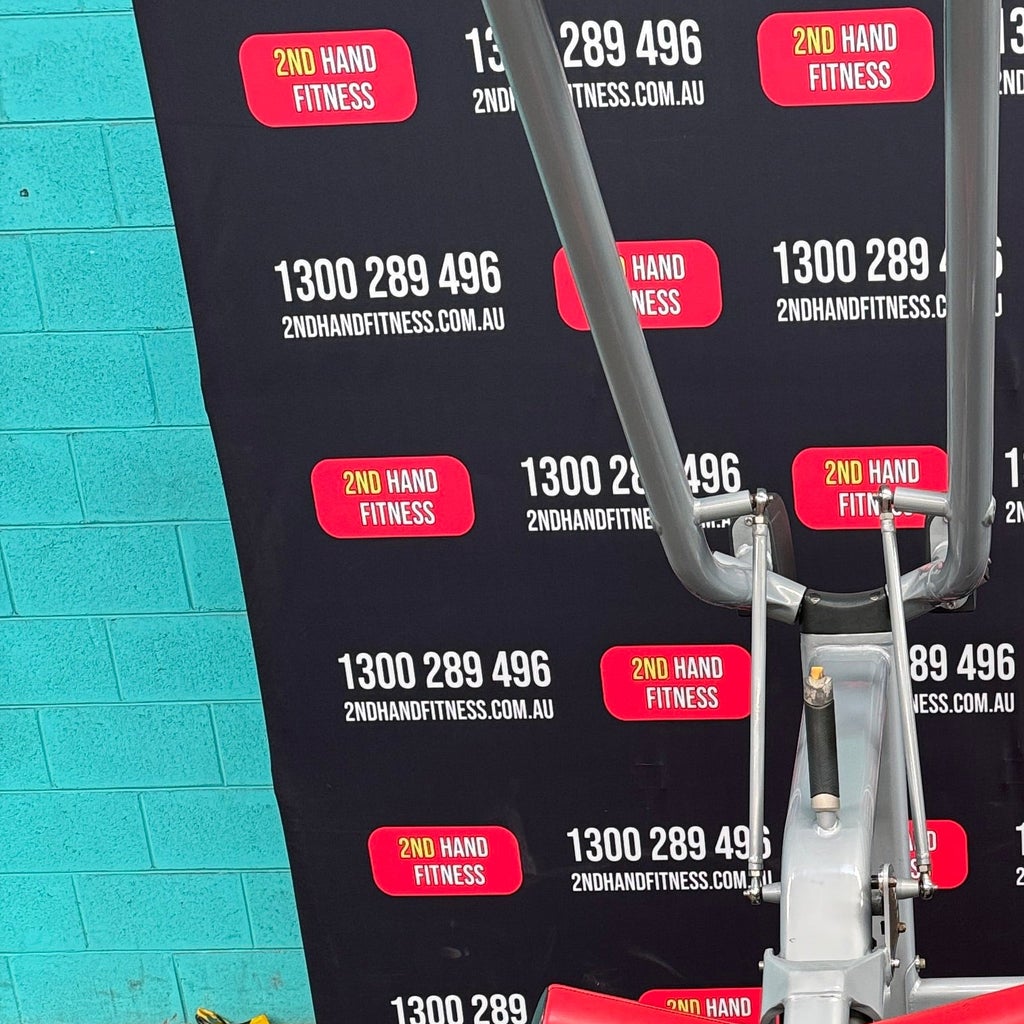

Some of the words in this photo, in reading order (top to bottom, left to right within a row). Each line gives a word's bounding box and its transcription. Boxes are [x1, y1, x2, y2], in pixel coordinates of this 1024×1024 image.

[465, 27, 505, 73] 13
[559, 19, 627, 68] 289
[635, 18, 703, 66] 496
[793, 26, 835, 55] 2ND
[841, 23, 897, 53] HAND
[273, 47, 316, 76] 2ND
[319, 44, 377, 74] HAND
[808, 60, 892, 91] FITNESS
[292, 81, 375, 112] FITNESS
[472, 80, 705, 114] 2NDTNESS.COM.AU
[631, 253, 686, 281] HAND
[772, 238, 857, 285] 1300
[865, 236, 930, 282] 289
[274, 256, 358, 302] 1300
[365, 253, 430, 299] 289
[438, 250, 502, 295] 496
[631, 288, 681, 315] NESS
[776, 293, 1003, 322] 2NDHANDFITNESS.C
[281, 306, 506, 339] 2NDHANDFITNESS.COM.AU
[343, 470, 382, 495] 2ND
[386, 468, 438, 494] HAND
[520, 454, 602, 497] 1300
[609, 454, 647, 496] 28
[684, 452, 742, 493] 496
[824, 460, 863, 485] 2ND
[868, 458, 920, 484] HAND
[359, 500, 436, 526] FITNESS
[838, 492, 913, 517] FITN
[337, 651, 416, 690] 1300
[422, 650, 484, 689] 289
[491, 649, 552, 688] 496
[631, 657, 669, 680] 2ND
[673, 656, 723, 679] HAND
[909, 644, 948, 682] 89
[956, 642, 1016, 681] 496
[343, 698, 554, 722] 2NDHANDFITNESS.COM.AU
[646, 686, 719, 709] FITNESS
[398, 837, 435, 859] 2ND
[439, 836, 489, 858] HAND
[566, 826, 642, 862] 1300
[649, 825, 707, 861] 289
[414, 864, 486, 886] FITNESS
[705, 997, 752, 1017] HAND
